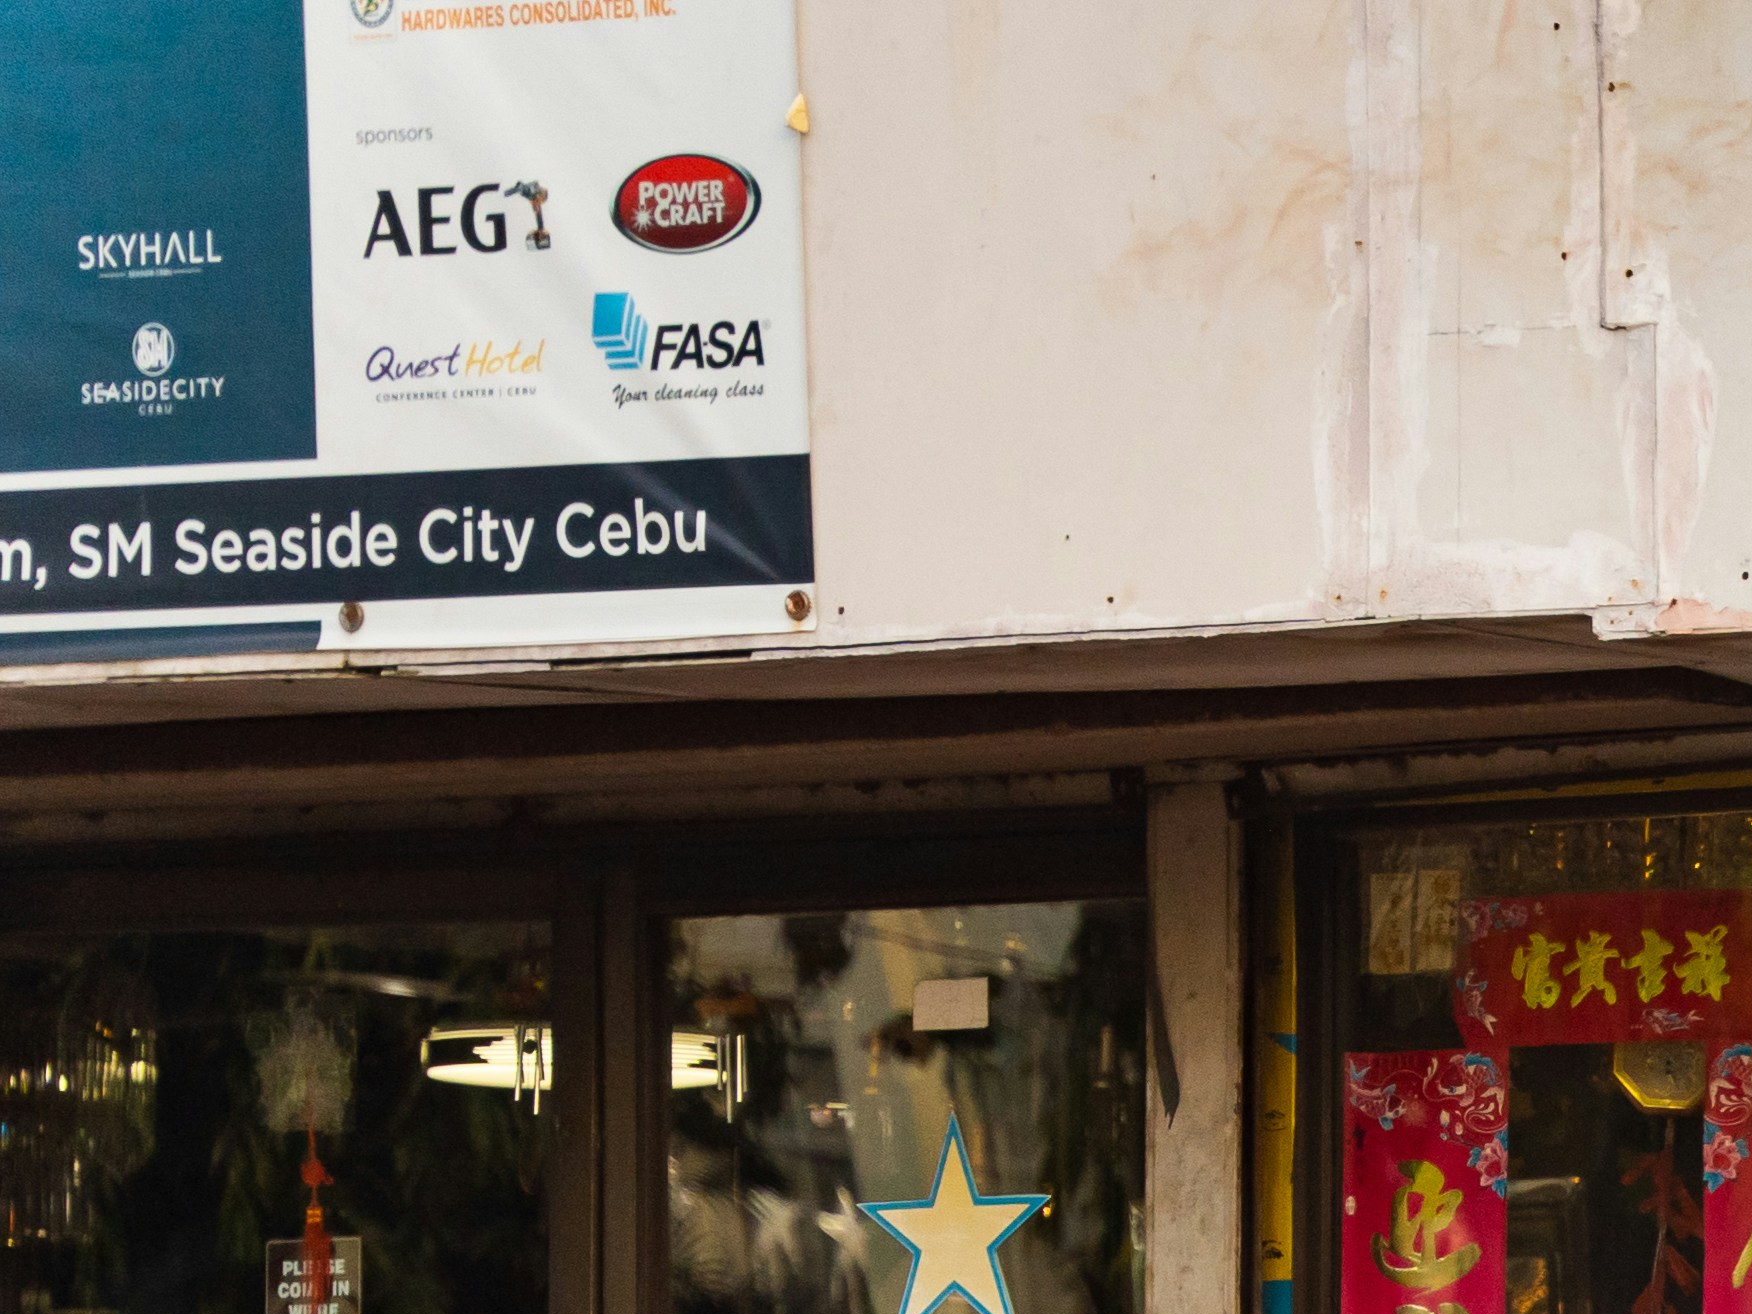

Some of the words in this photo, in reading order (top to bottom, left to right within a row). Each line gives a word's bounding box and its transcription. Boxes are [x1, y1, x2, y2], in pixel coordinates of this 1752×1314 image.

[401, 4, 505, 31] HARDWARES
[510, 0, 640, 26] CONSOLIDATED,
[643, 0, 677, 17] INC.
[356, 126, 433, 147] sponsors
[639, 180, 724, 203] POWER
[363, 183, 508, 259] AEG
[655, 201, 726, 228] CRAFT
[77, 229, 223, 271] SKYHALL
[366, 342, 460, 383] Quest
[464, 338, 546, 377] Hotel
[81, 376, 225, 405] SEASIDECITY
[375, 389, 447, 403] CONFERENCE
[612, 382, 649, 409] Your
[654, 386, 718, 405] cleaning
[724, 380, 765, 397] class
[69, 524, 153, 581] SM
[174, 512, 399, 575] Seaside
[418, 505, 536, 573] City
[555, 498, 708, 562] Cebu
[1510, 924, 1731, 1009] 富貴吉祥
[332, 1280, 350, 1297] IN
